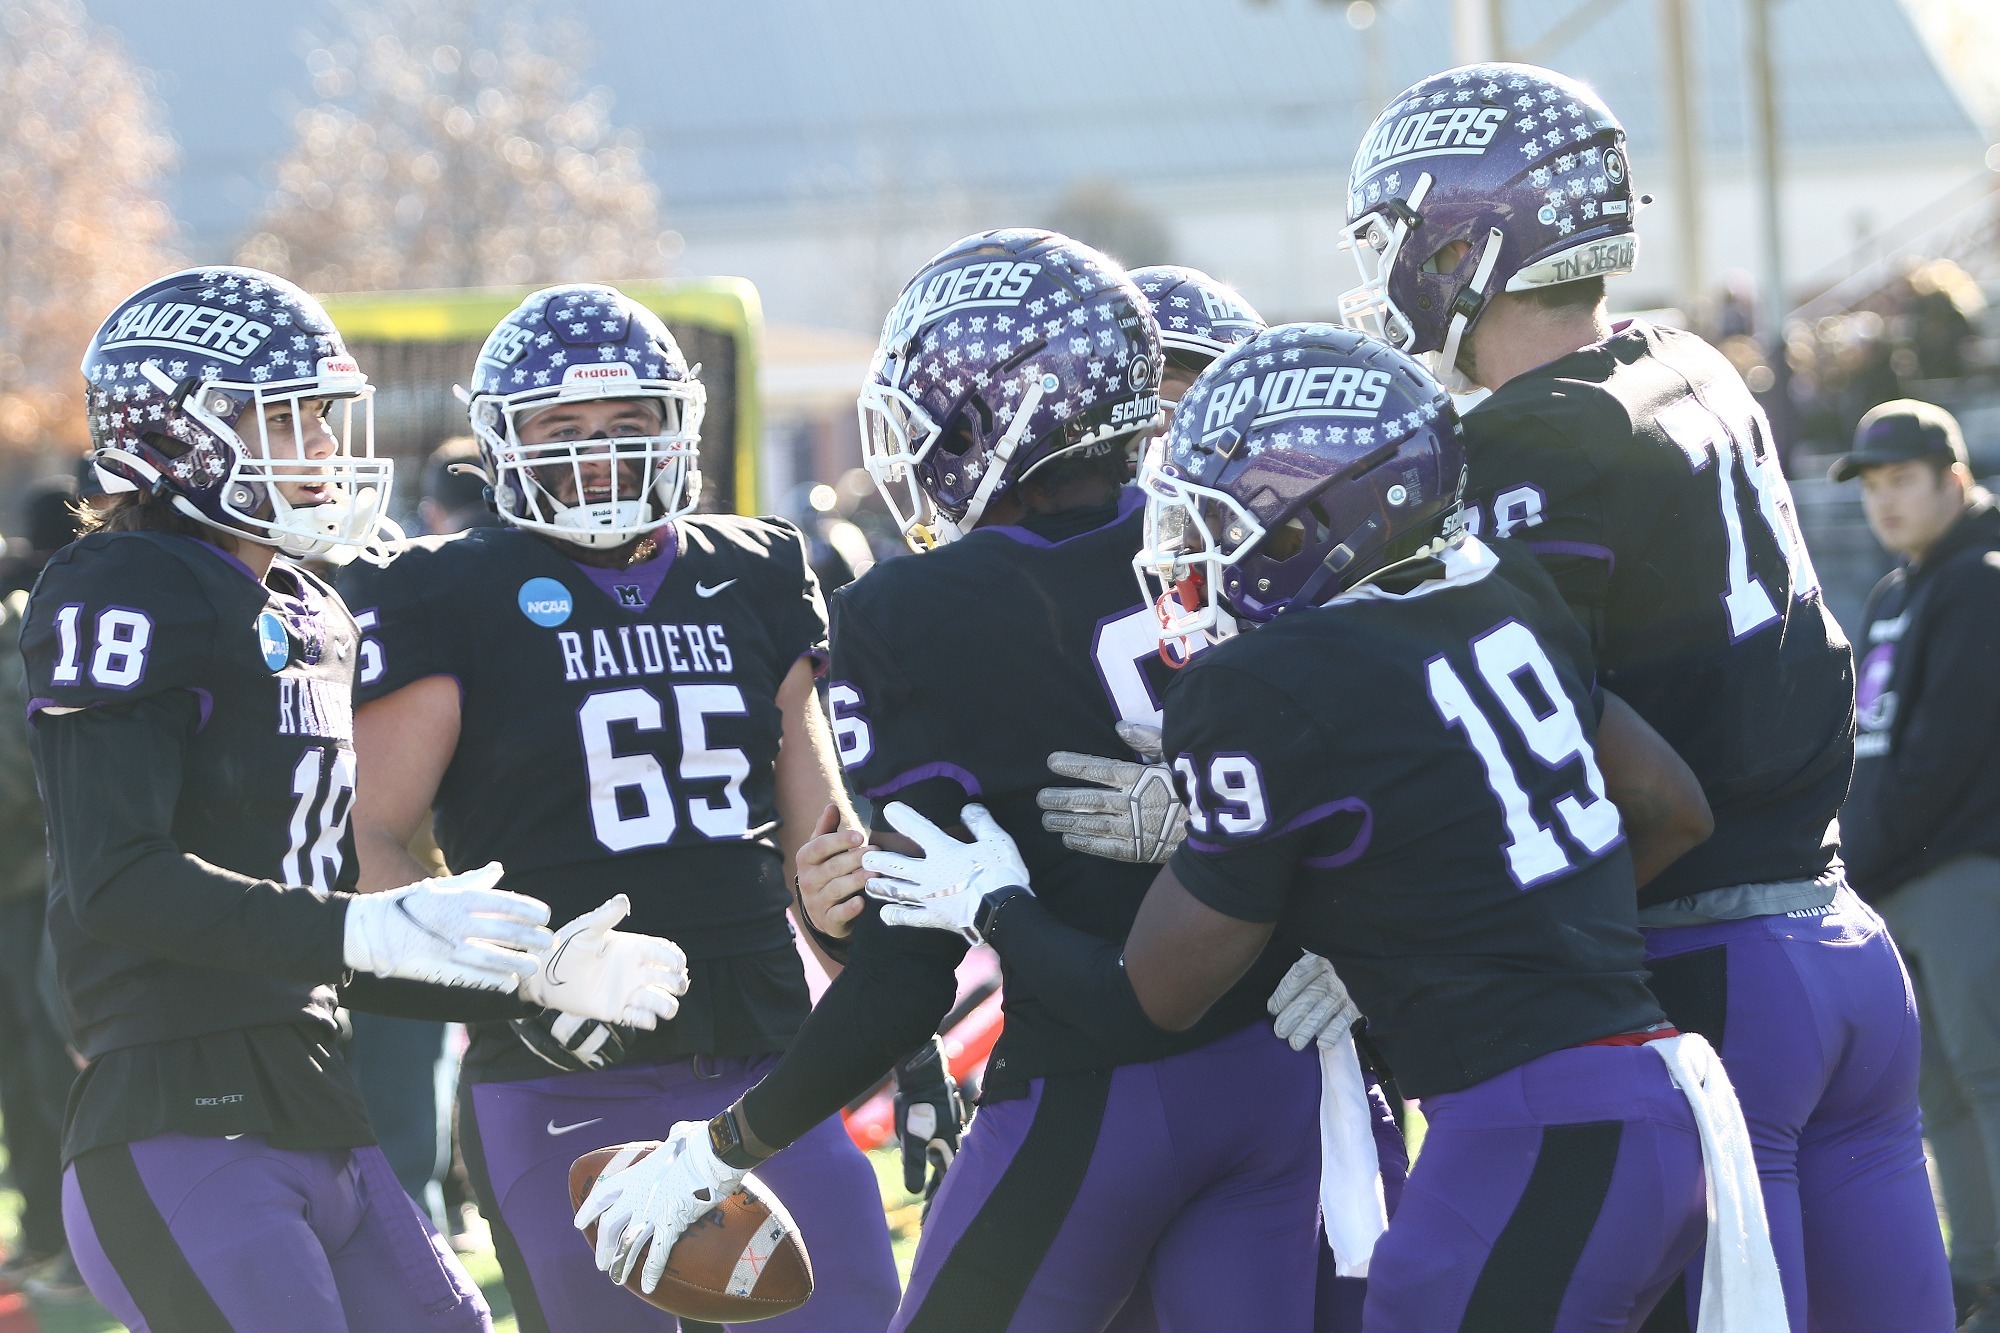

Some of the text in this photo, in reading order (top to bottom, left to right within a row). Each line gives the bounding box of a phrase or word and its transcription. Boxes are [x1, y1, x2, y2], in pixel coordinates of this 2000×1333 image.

[1354, 107, 1508, 180] RAIDERS
[1551, 254, 1581, 282] IN
[108, 302, 273, 358] RAIDERS
[886, 261, 1043, 340] RAIDERS
[574, 368, 629, 379] Riddell
[1203, 366, 1392, 434] RAIDERS
[1111, 393, 1161, 423] schut
[527, 600, 570, 613] NCAA
[614, 584, 646, 607] M
[52, 605, 151, 687] 18
[558, 624, 735, 682] RAIDERS
[830, 684, 870, 767] 6
[1426, 618, 1622, 885] 19
[577, 683, 751, 851] 65
[1174, 754, 1266, 835] 19
[195, 1094, 244, 1105] DRI-FIT
